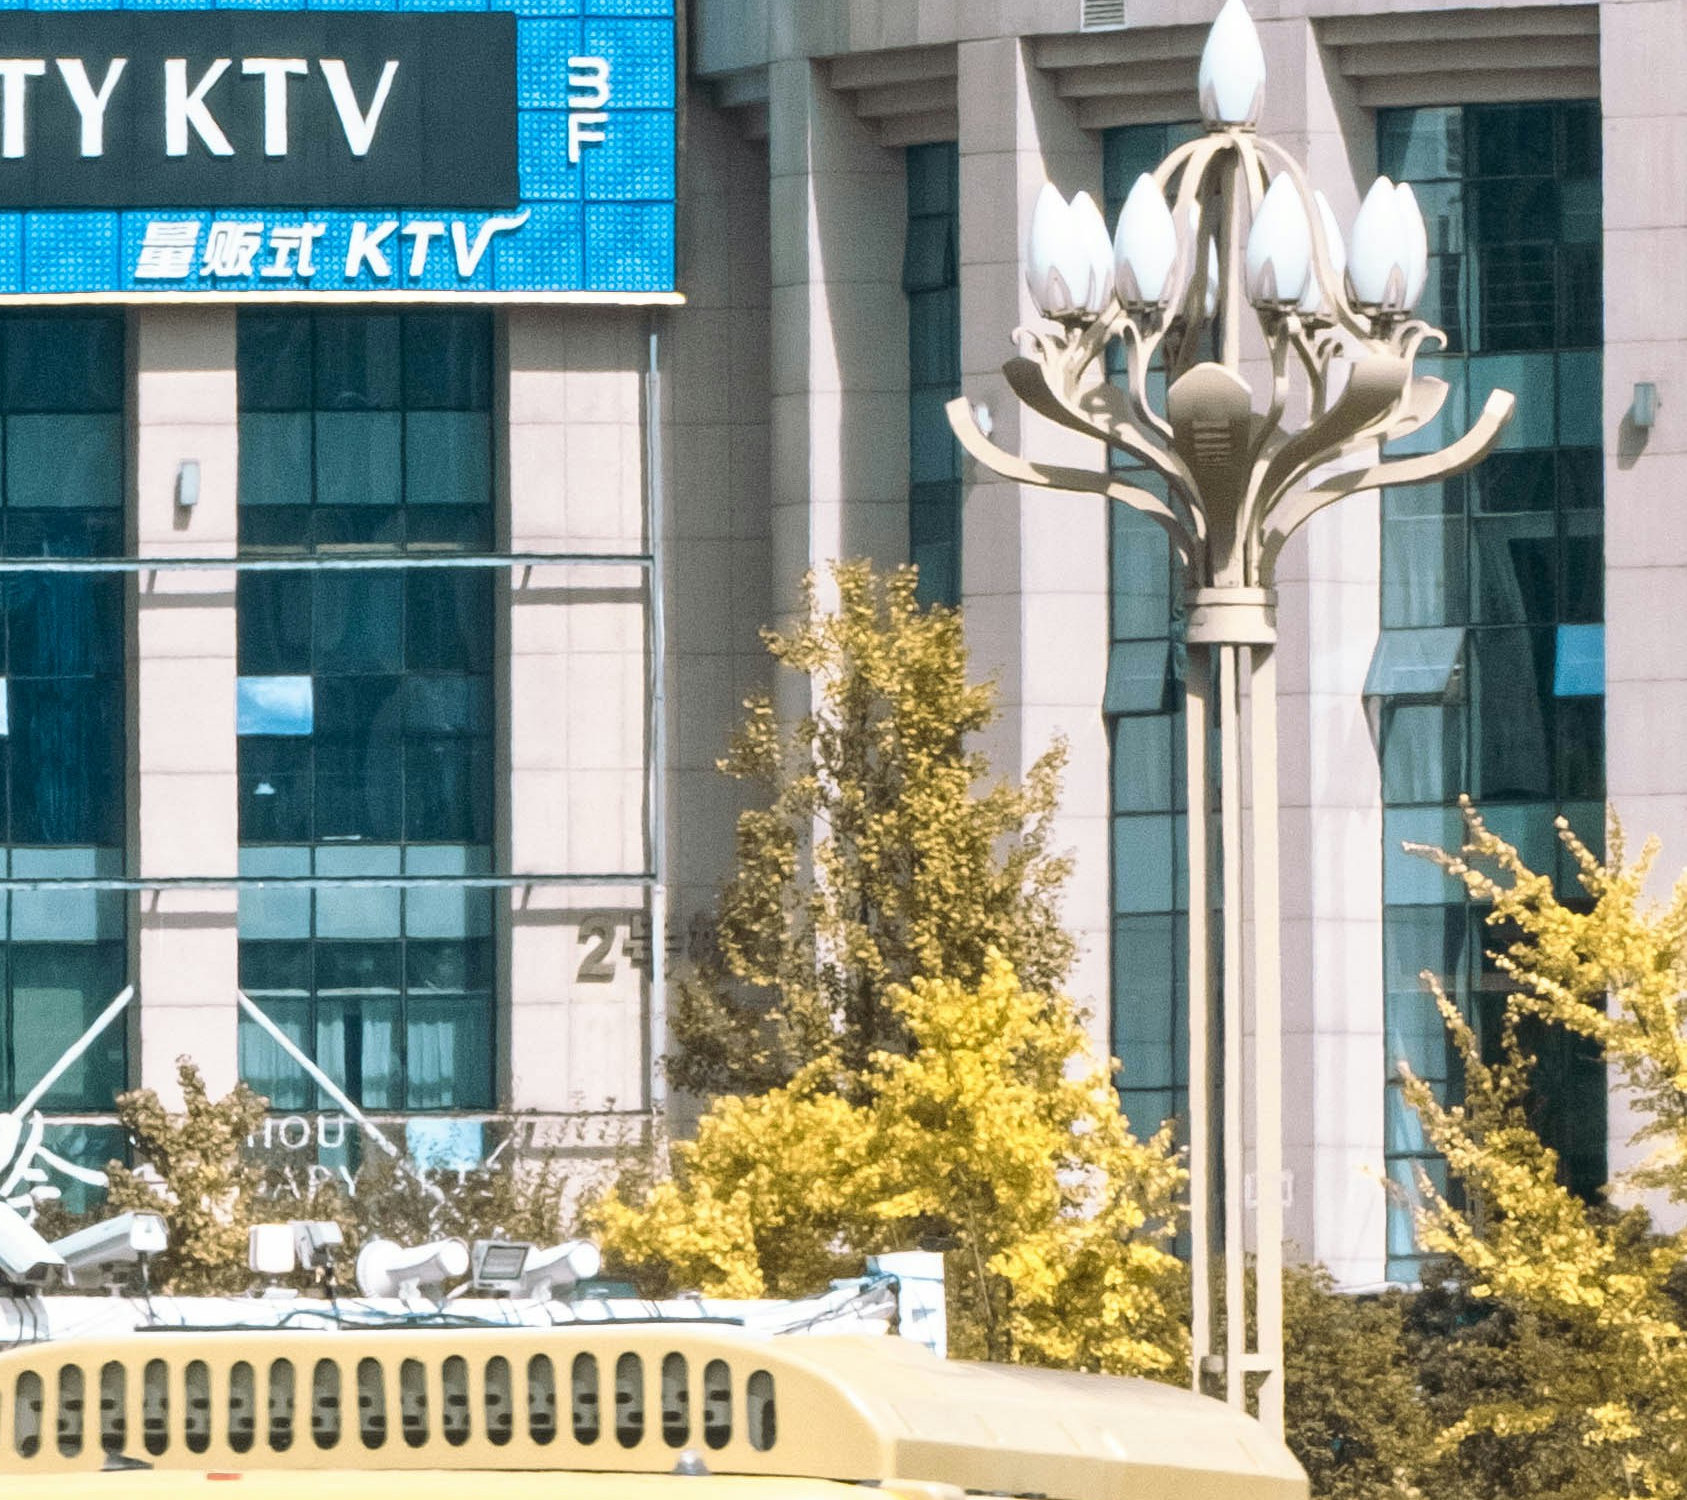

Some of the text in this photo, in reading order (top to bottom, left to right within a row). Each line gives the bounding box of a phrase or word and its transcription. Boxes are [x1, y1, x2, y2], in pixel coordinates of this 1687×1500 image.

[165, 57, 400, 158] KTV
[134, 207, 532, 280] 量贩式 KTV
